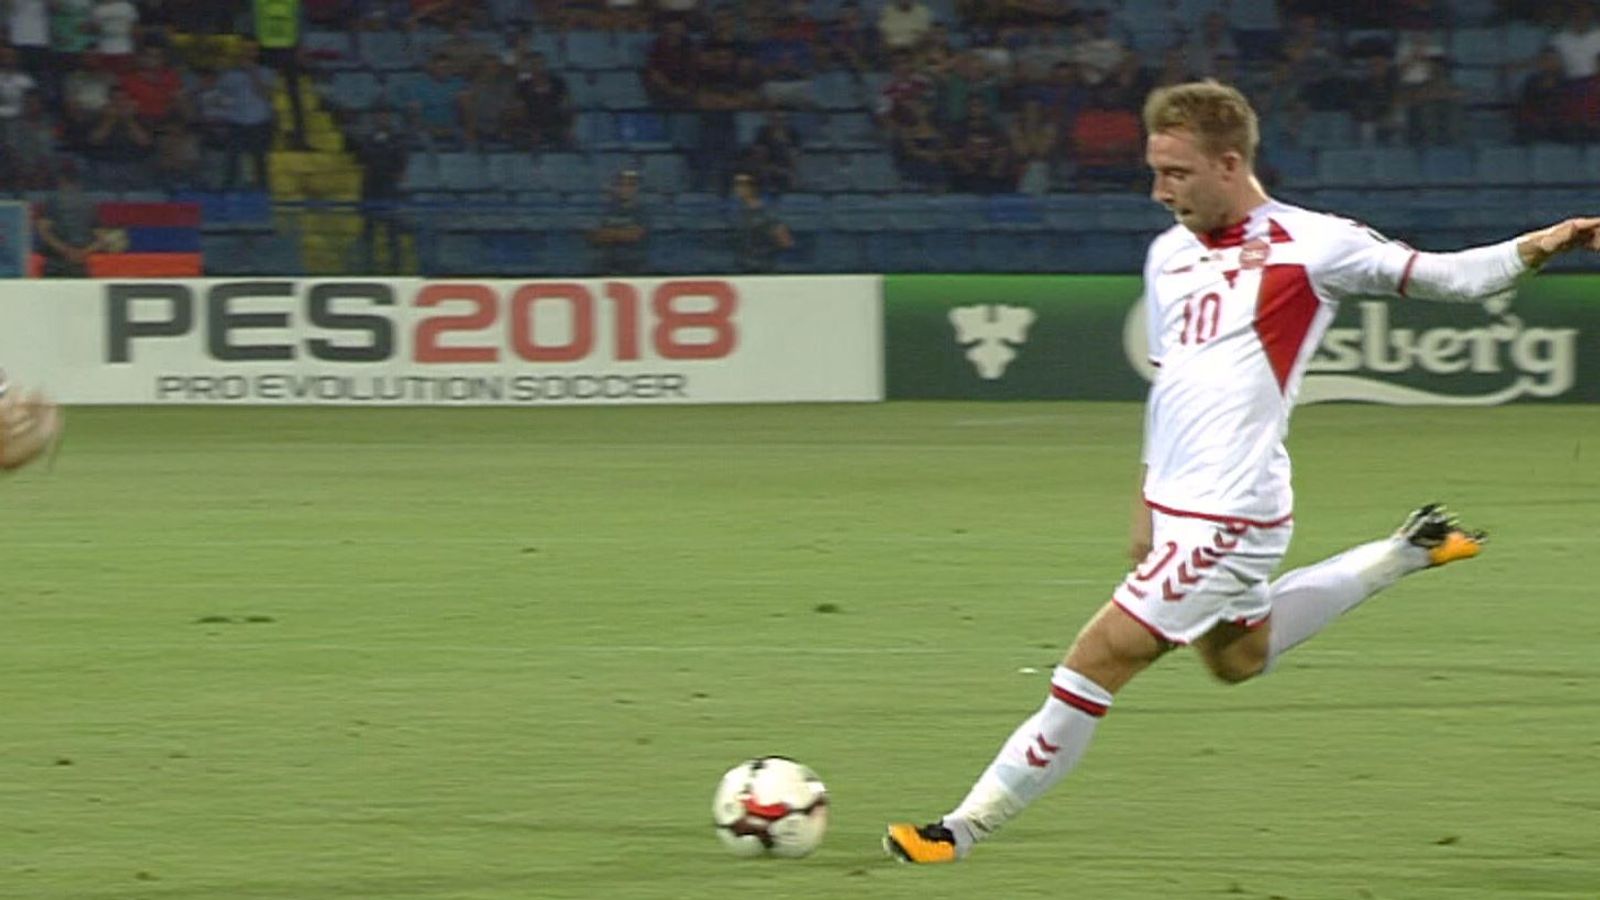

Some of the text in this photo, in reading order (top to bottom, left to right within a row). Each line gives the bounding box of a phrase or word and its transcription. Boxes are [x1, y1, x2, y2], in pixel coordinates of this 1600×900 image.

[1179, 292, 1222, 346] 10
[1124, 299, 1577, 402] sberg
[157, 373, 689, 401] PRO EVOLUTION SOCCER
